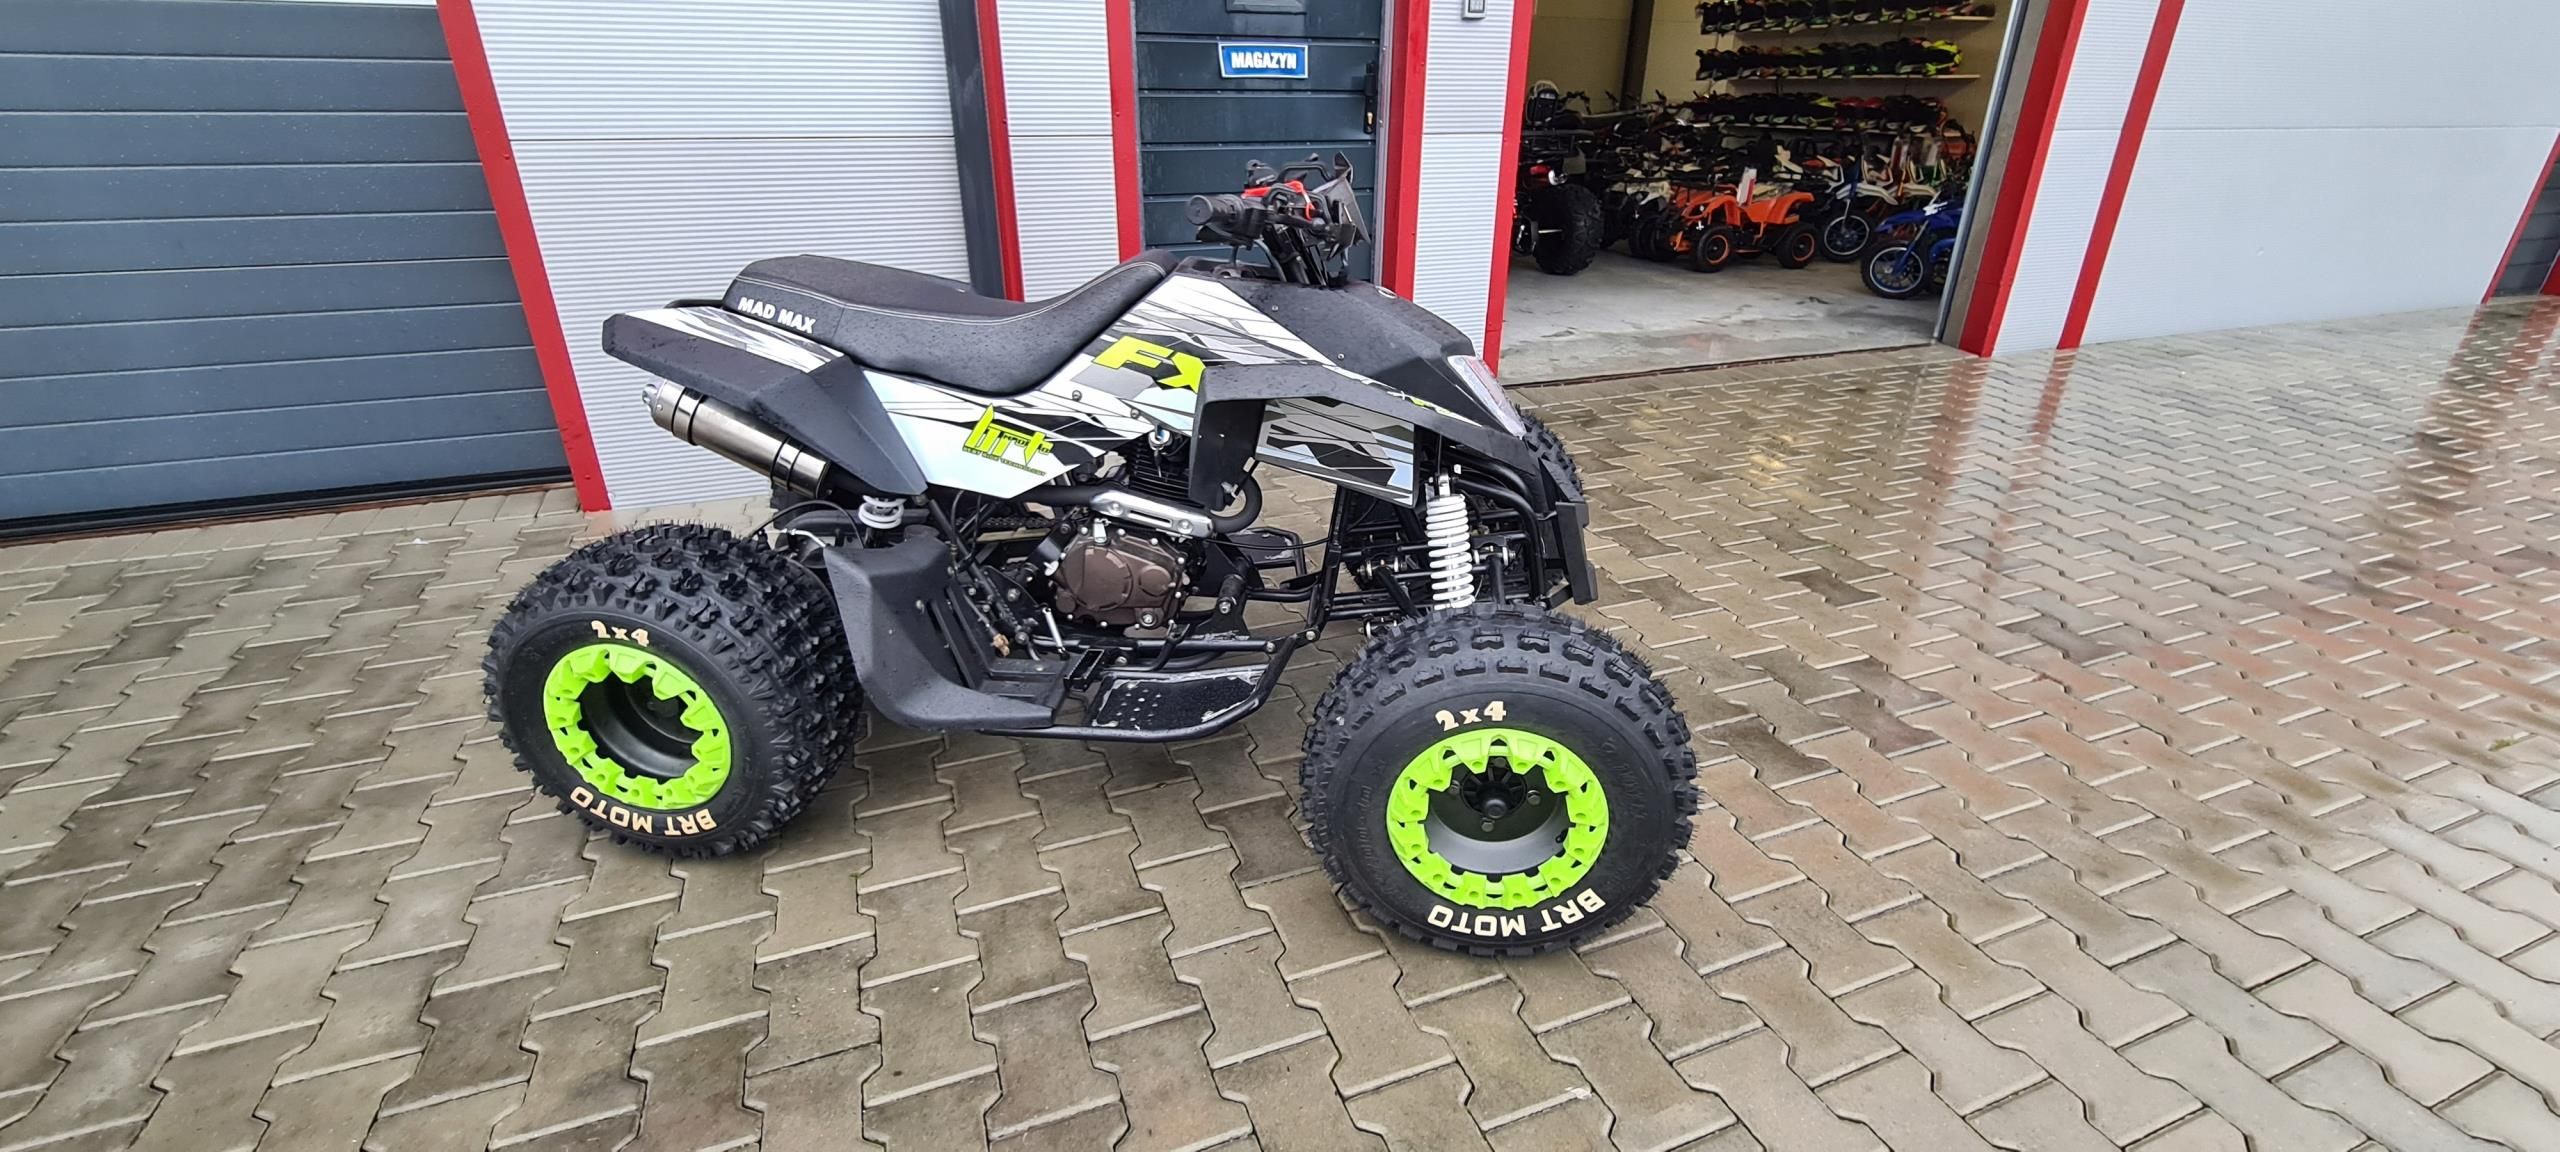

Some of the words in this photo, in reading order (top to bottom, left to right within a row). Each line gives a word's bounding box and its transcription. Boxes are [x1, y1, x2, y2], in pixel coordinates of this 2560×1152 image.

[1230, 51, 1297, 70] MAGAZYN
[737, 296, 776, 321] MAD
[778, 308, 817, 334] MAX
[1435, 700, 1507, 731] 2x4
[570, 785, 653, 834] MOTO
[664, 808, 717, 836] BRT
[1427, 904, 1527, 937] MOTO
[1540, 887, 1606, 932] BRT
